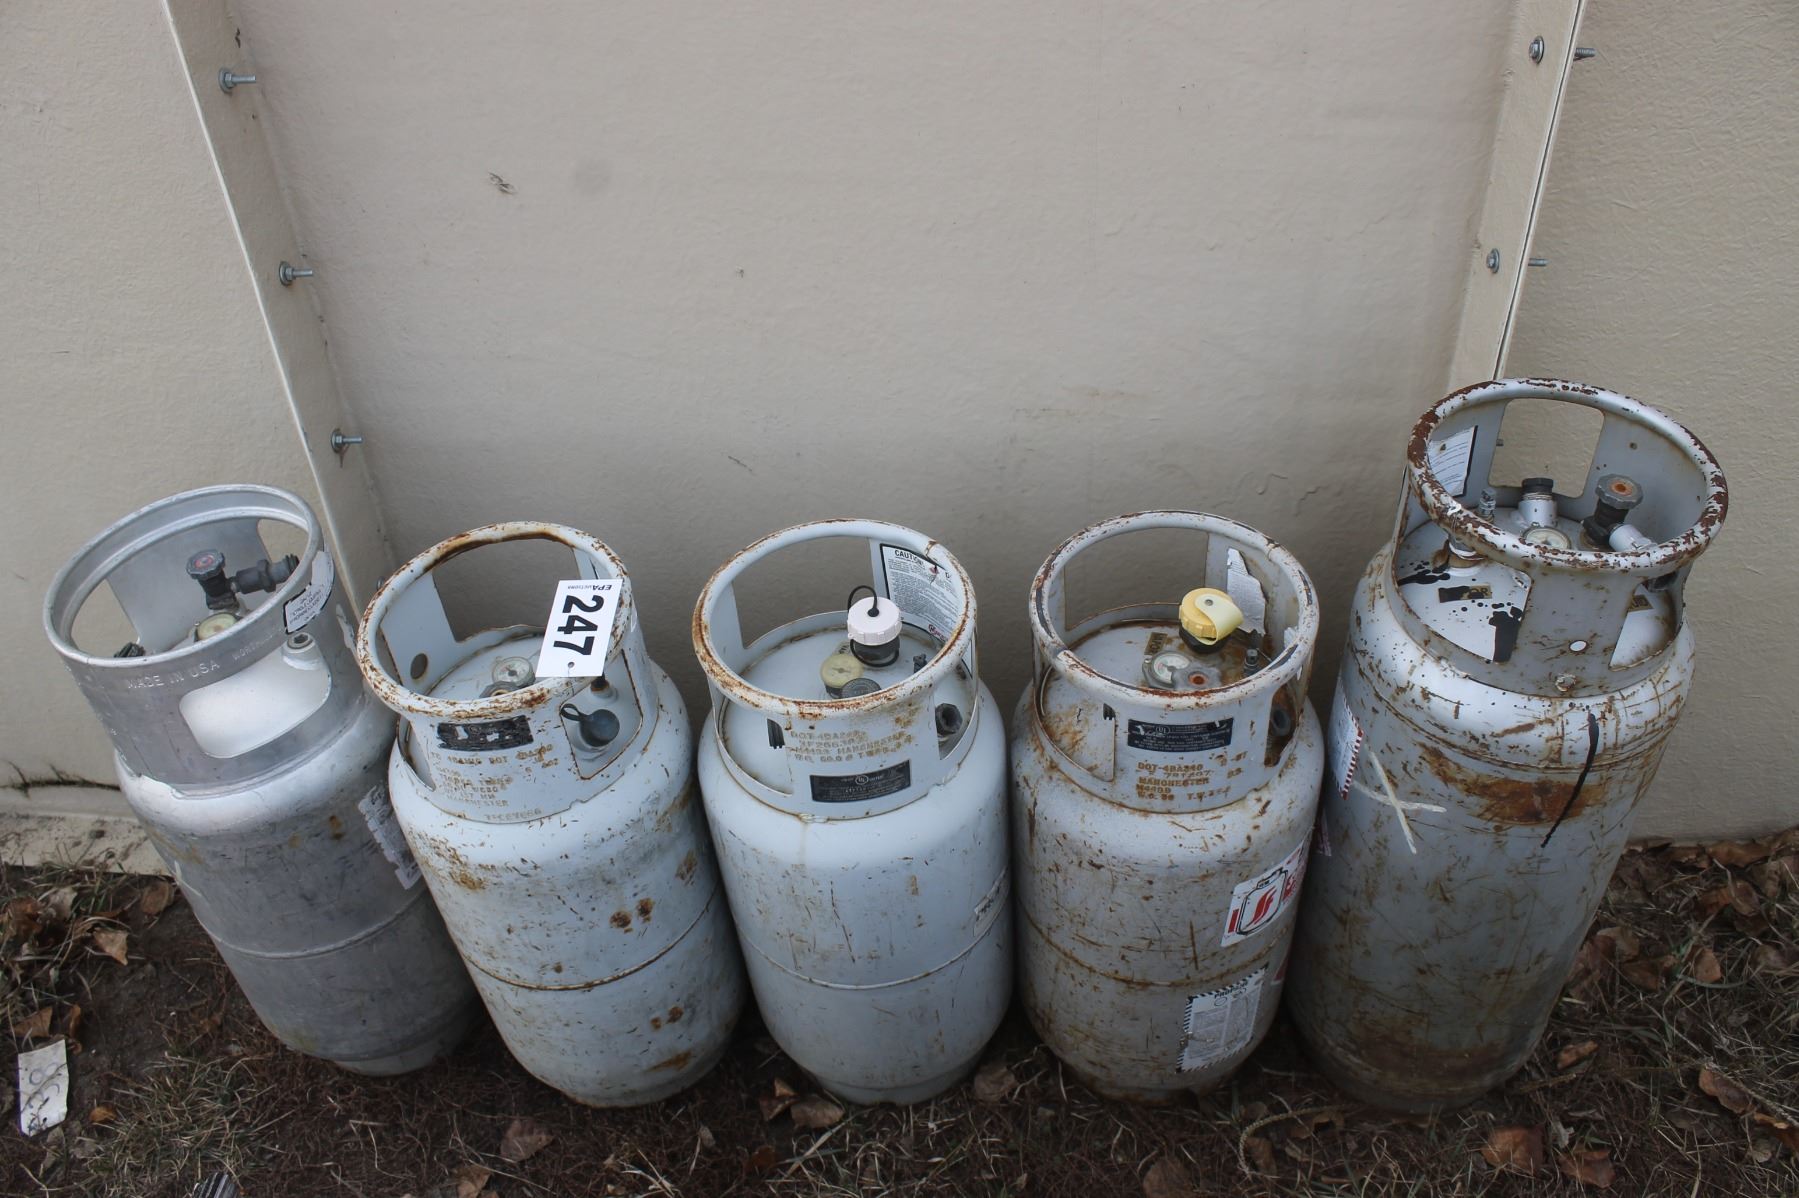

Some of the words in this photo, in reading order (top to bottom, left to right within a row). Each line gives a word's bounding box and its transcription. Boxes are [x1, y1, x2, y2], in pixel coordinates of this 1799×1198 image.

[553, 594, 605, 656] 247
[127, 675, 165, 689] MADE
[170, 671, 185, 684] IN
[191, 661, 220, 678] USA
